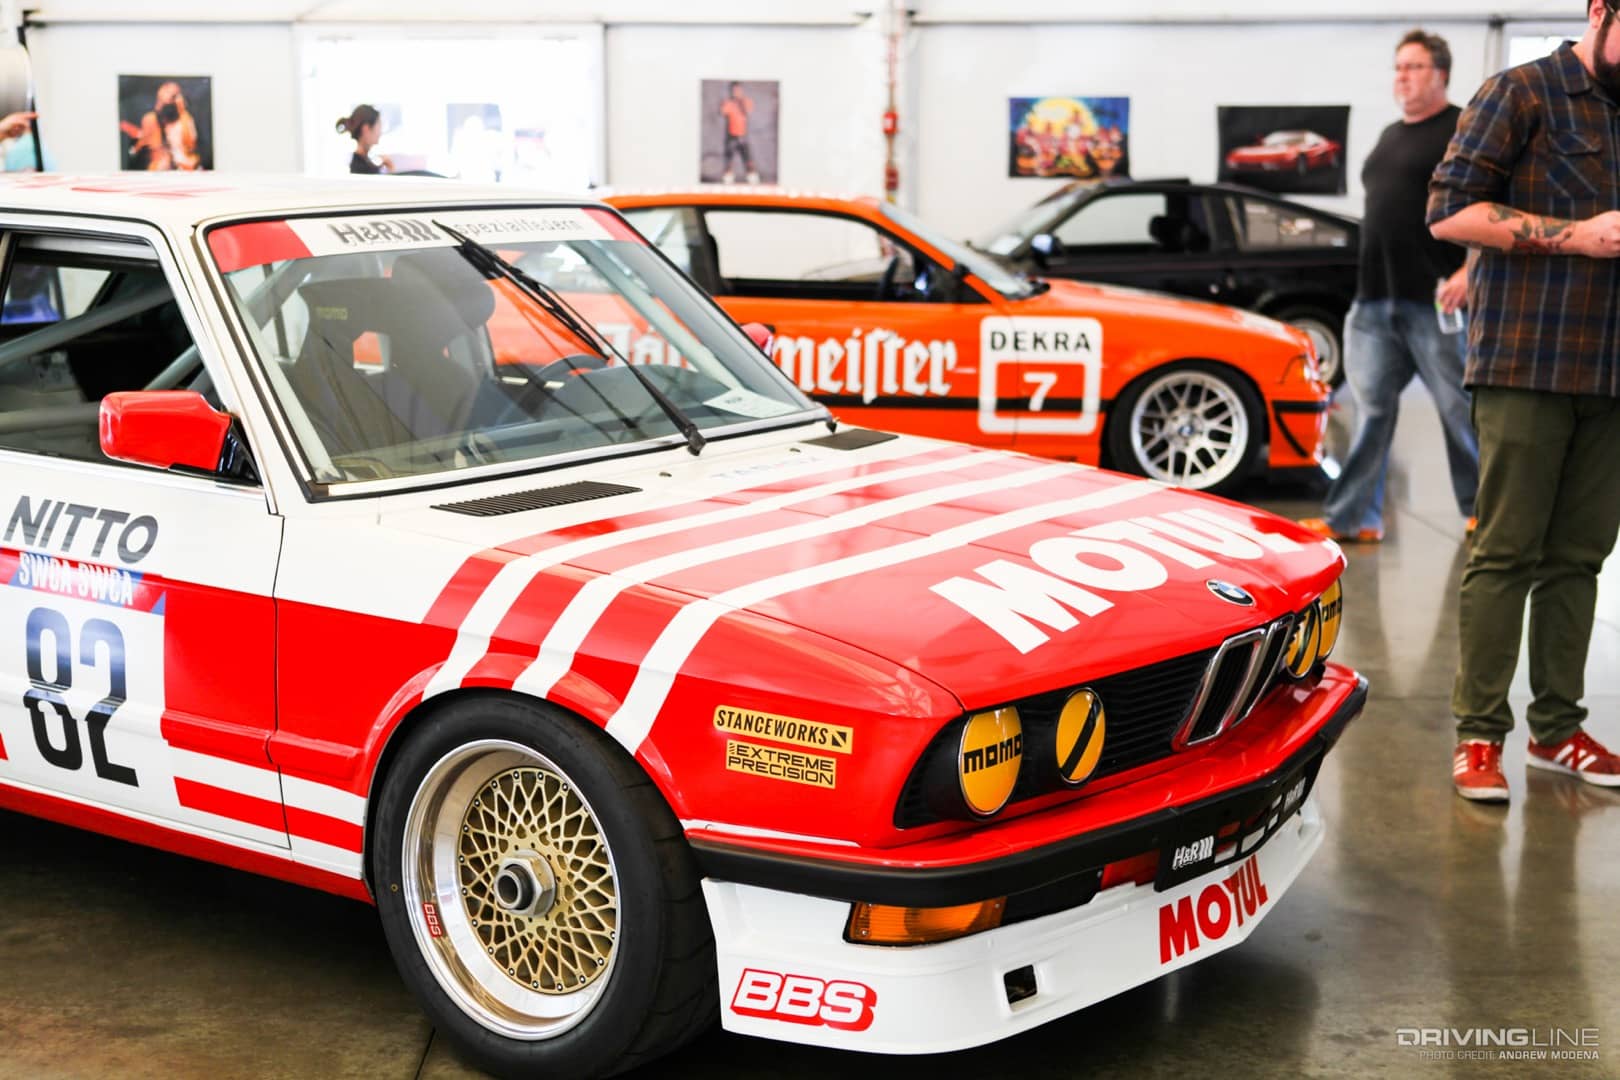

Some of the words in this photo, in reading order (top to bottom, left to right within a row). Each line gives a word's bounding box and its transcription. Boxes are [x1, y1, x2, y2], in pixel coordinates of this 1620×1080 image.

[329, 220, 402, 244] H&R
[990, 330, 1092, 352] DEKRA
[1023, 372, 1058, 412] 7
[3, 495, 159, 564] NITTO
[928, 508, 1305, 655] MOTUL
[23, 606, 139, 788] 82
[716, 709, 829, 745] STANCEWORKS
[728, 756, 834, 785] PRECISION
[736, 744, 834, 772] EXTREME
[963, 733, 1022, 774] momo
[1172, 839, 1202, 870] H&R
[1159, 854, 1269, 965] MOTUL
[730, 968, 878, 1032] BBS
